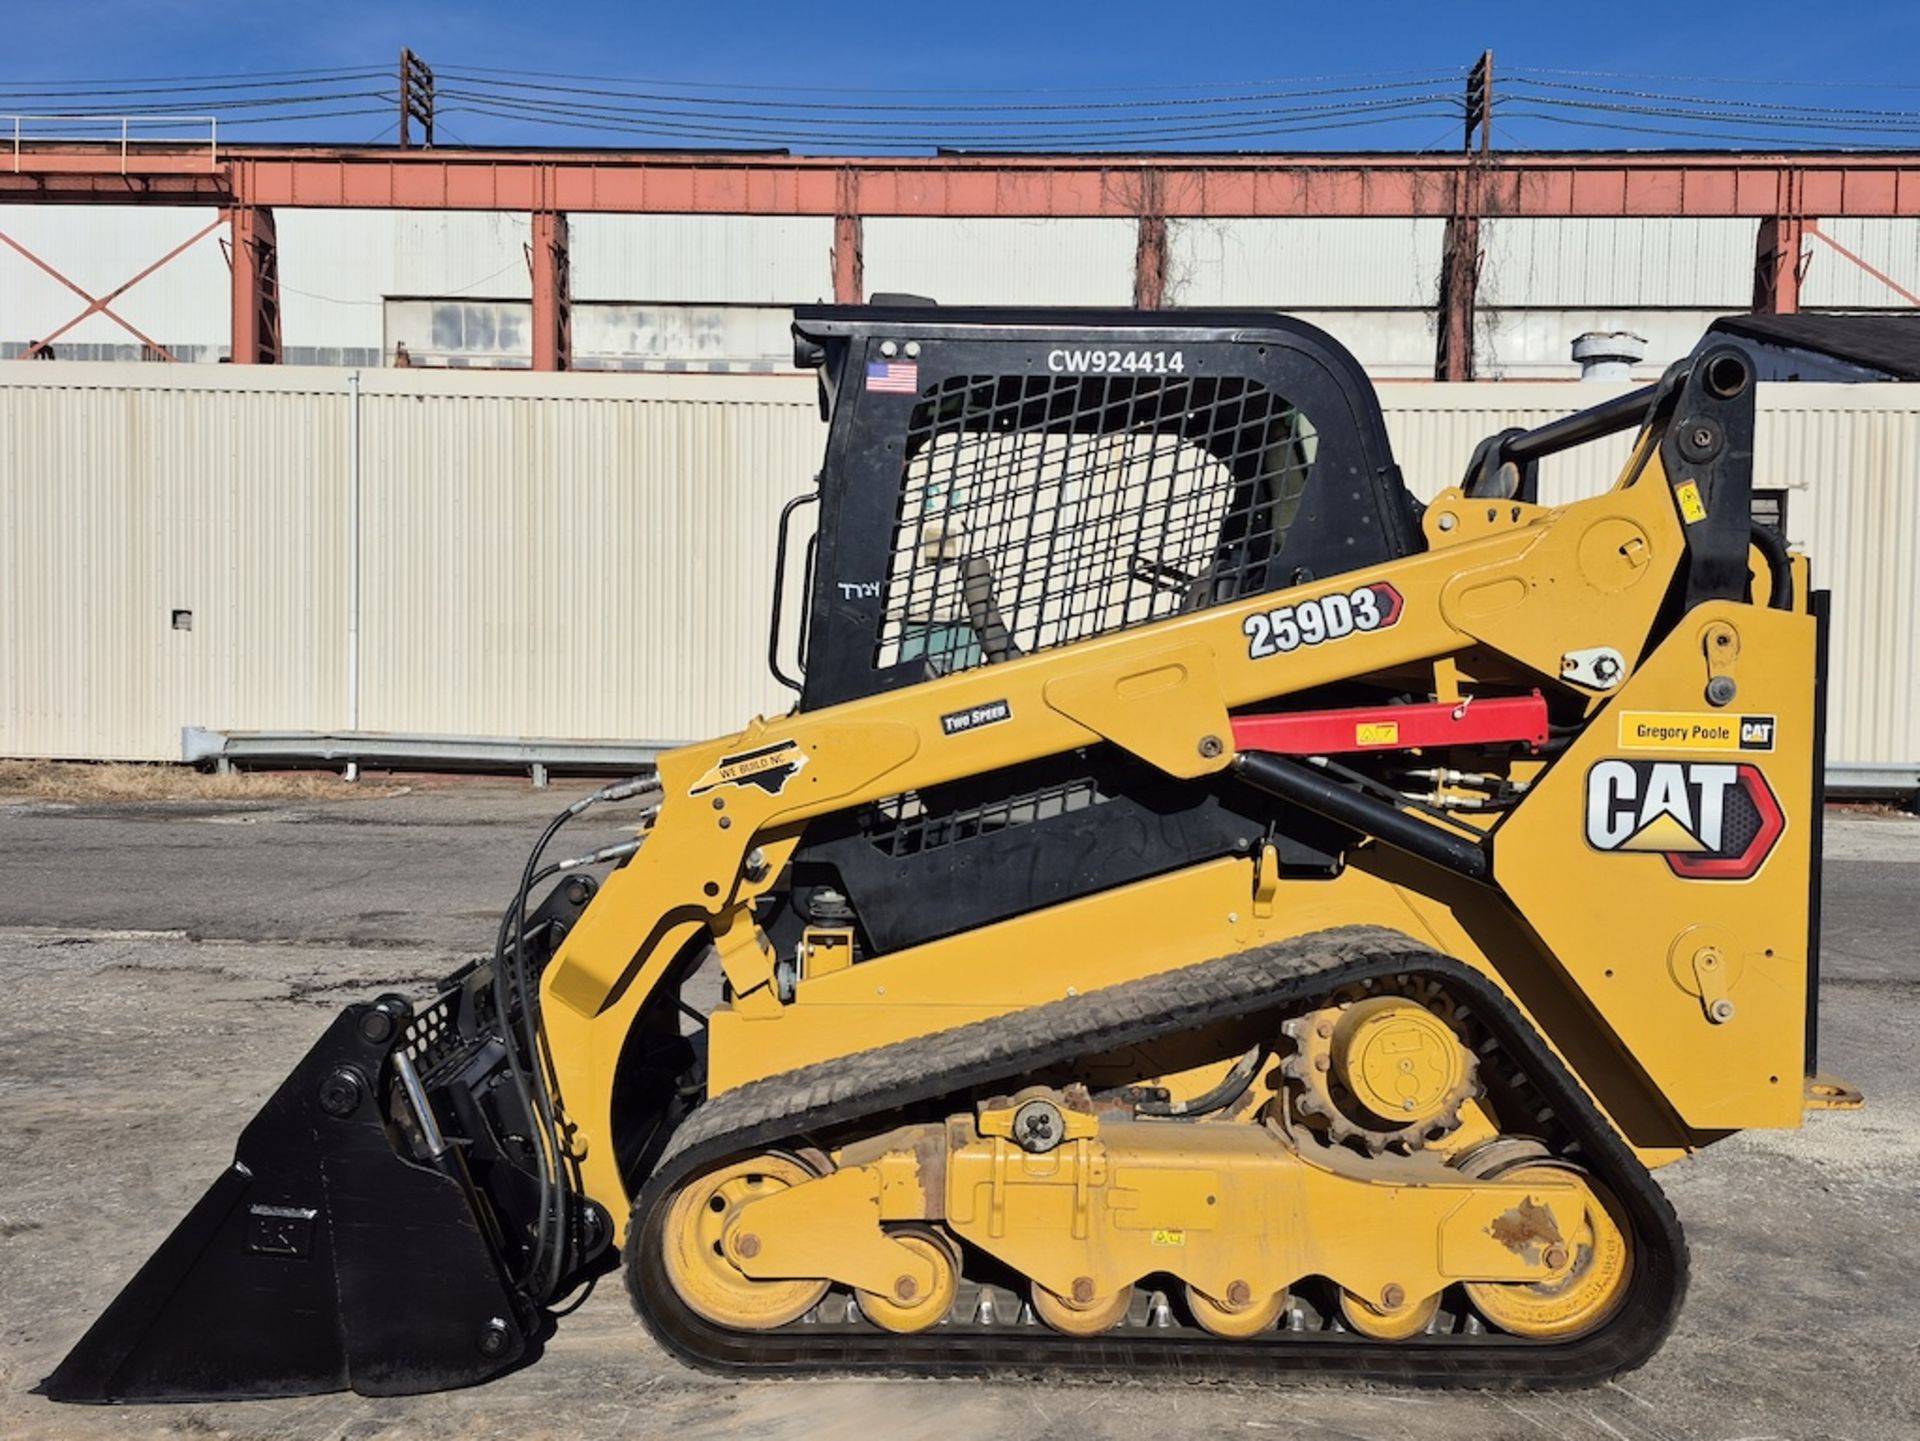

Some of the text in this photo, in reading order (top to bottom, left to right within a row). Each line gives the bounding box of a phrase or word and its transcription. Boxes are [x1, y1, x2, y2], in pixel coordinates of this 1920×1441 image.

[1048, 350, 1184, 373] CW924414
[1244, 587, 1380, 658] 259D3
[1637, 723, 1771, 743] Gregory Poole CAT
[719, 753, 786, 779] WE BUILD NC
[1588, 760, 1738, 852] CAT
